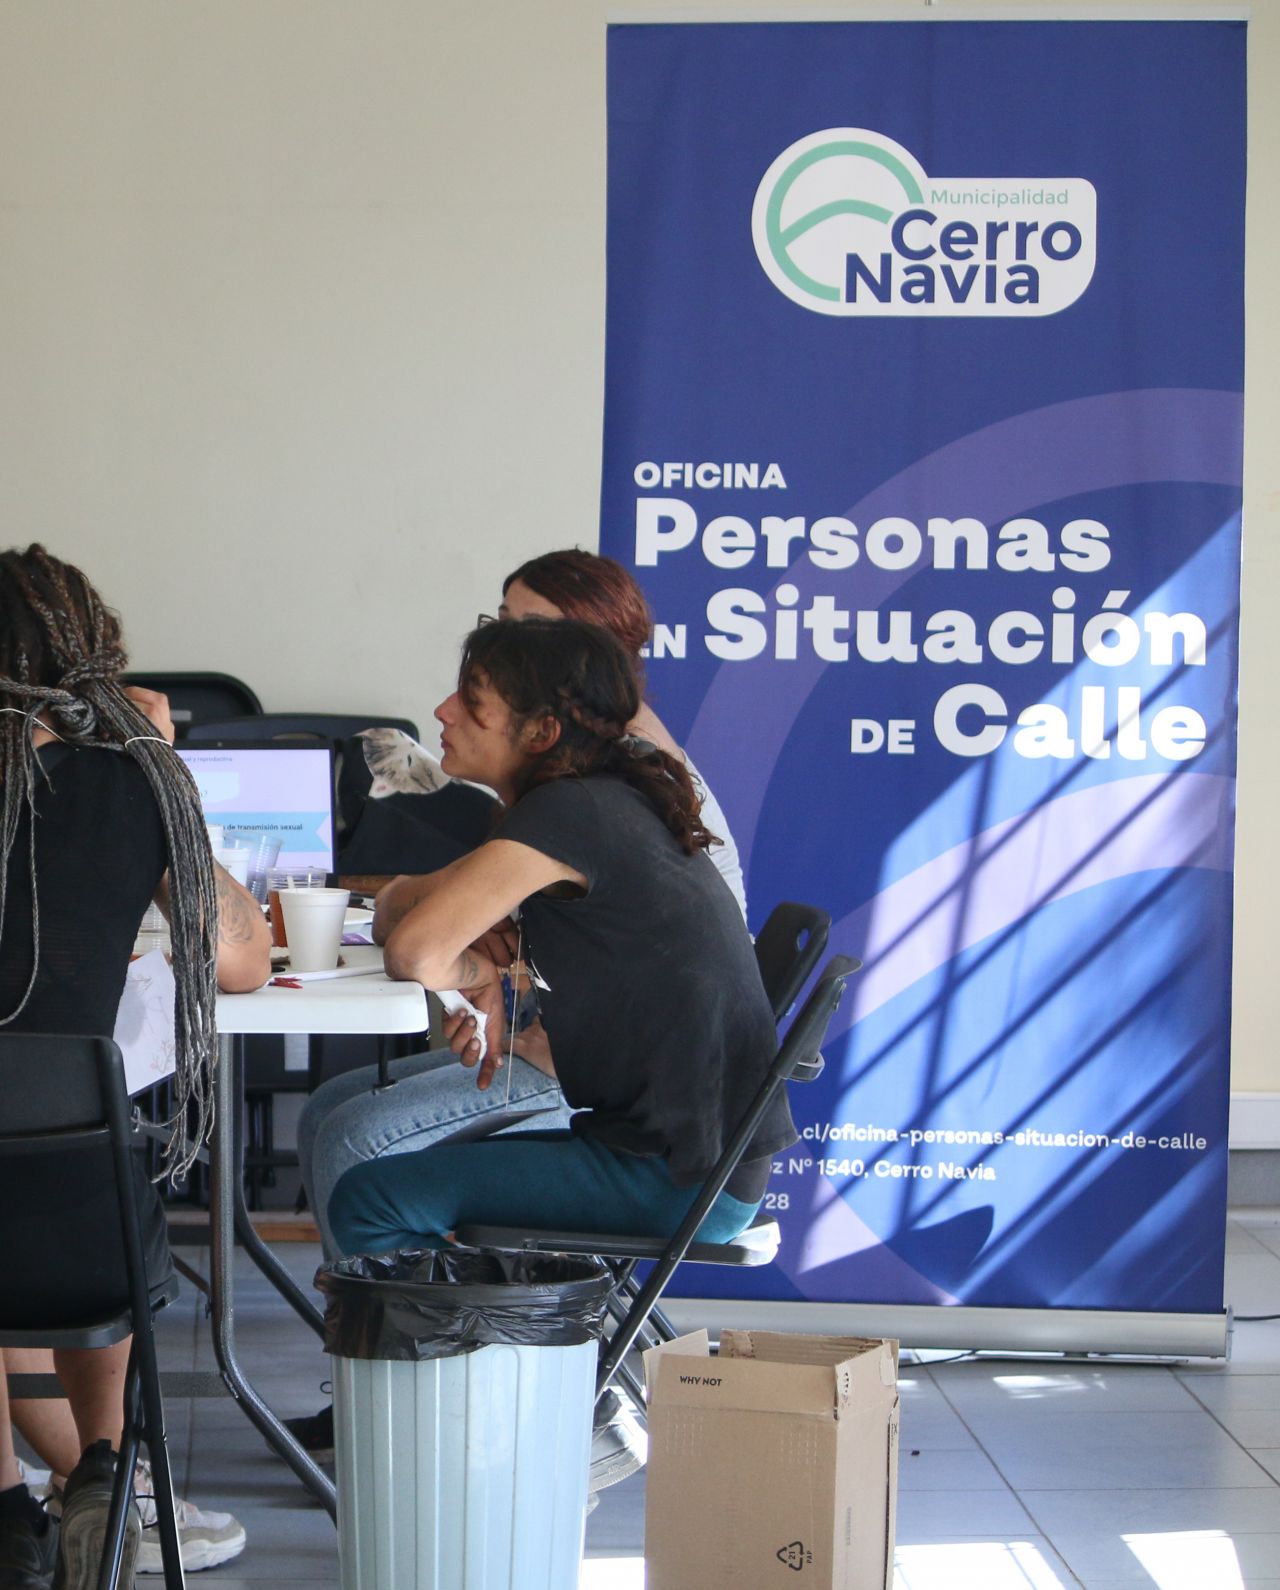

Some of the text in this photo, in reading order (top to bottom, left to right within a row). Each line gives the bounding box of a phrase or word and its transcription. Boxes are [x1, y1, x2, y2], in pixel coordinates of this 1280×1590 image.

[930, 189, 1069, 208] Municipalidad
[891, 209, 1082, 261] Cerro
[845, 253, 1040, 304] Navia
[633, 462, 787, 489] OFICINA
[634, 498, 1112, 573] Personas
[639, 584, 1207, 667] N Situación
[850, 684, 1207, 761] DE Calle
[237, 823, 279, 831] transmisión
[280, 823, 303, 831] sexual
[817, 1159, 869, 1179] 1540,
[873, 1160, 933, 1179] Cerro
[938, 1162, 997, 1181] Navia
[680, 1375, 723, 1387] WHY NOT
[788, 1551, 796, 1560] 21
